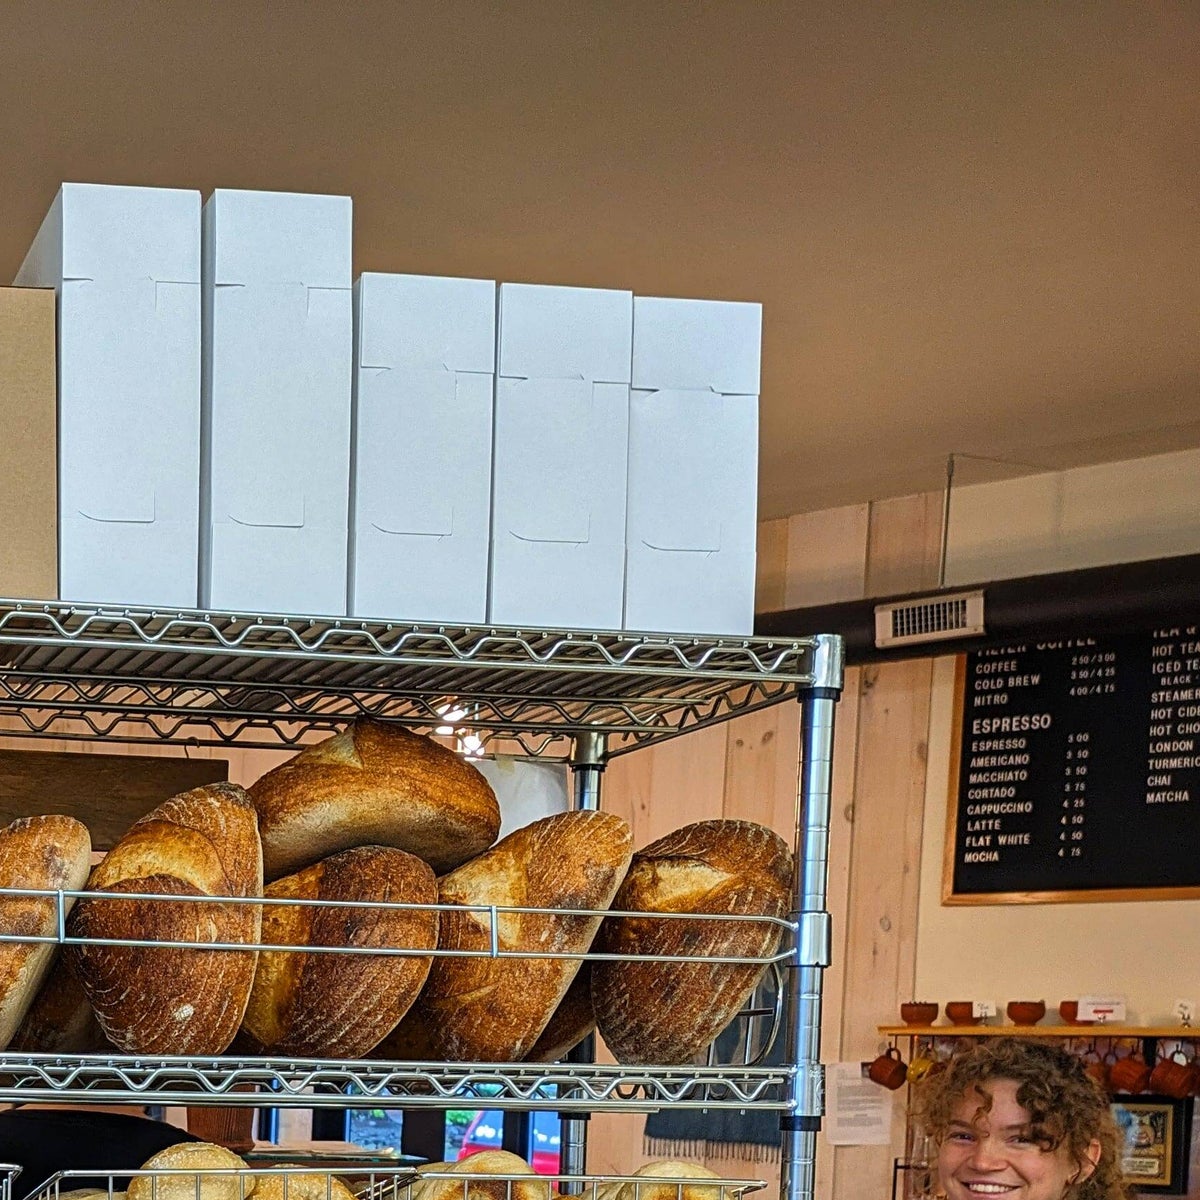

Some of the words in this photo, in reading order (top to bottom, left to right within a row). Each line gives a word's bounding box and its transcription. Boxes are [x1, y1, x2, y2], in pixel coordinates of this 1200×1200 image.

[1152, 644, 1174, 657] HOT
[975, 660, 1017, 674] COFFEE
[1152, 661, 1181, 675] ICED
[974, 678, 1004, 691] COLD
[1008, 673, 1041, 688] BREW
[1160, 674, 1191, 686] BLACK
[973, 692, 1009, 707] NITRO
[1150, 707, 1173, 720] HOT
[972, 713, 1052, 734] ESPRESSO
[1149, 724, 1172, 737] HOT
[971, 738, 1027, 752] ESPRESSO
[1148, 740, 1194, 754] LONDON
[970, 753, 1030, 768] AMERICANO
[968, 770, 1028, 784] MACCHIATO
[1146, 774, 1172, 787] CHAI
[967, 786, 1016, 799] CORTADO
[1145, 790, 1190, 804] MATCHA
[966, 802, 1033, 815] CAPPUCCINO
[967, 819, 1002, 831] LATTE
[965, 835, 992, 847] FLAT
[998, 833, 1031, 845] WHITE
[964, 851, 999, 863] MOCHA
